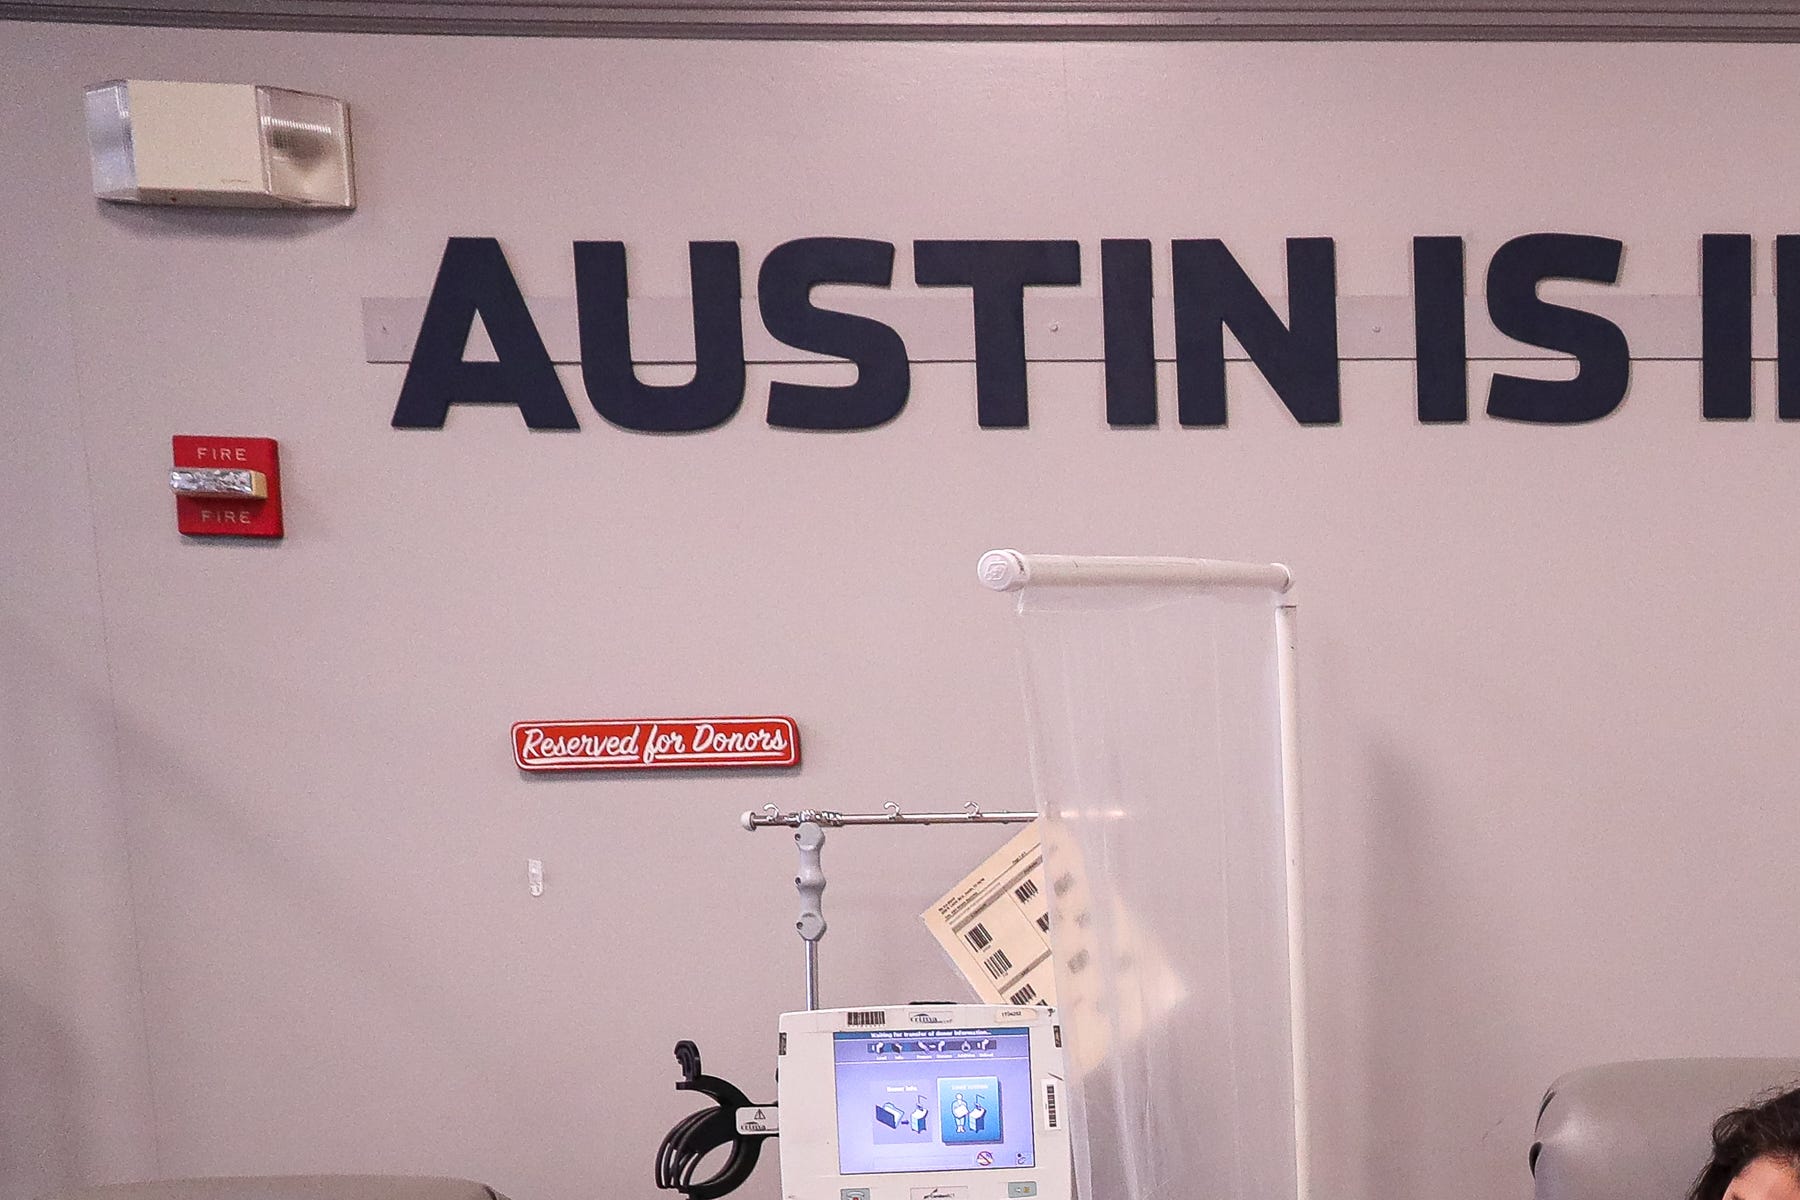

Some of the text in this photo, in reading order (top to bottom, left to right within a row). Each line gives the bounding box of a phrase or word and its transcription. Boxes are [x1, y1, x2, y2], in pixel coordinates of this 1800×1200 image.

[391, 236, 1341, 431] AUSTIN
[1412, 233, 1631, 425] IS
[197, 447, 247, 461] FIRE
[201, 510, 251, 524] FIRE
[523, 723, 787, 764] Reserved for Donors
